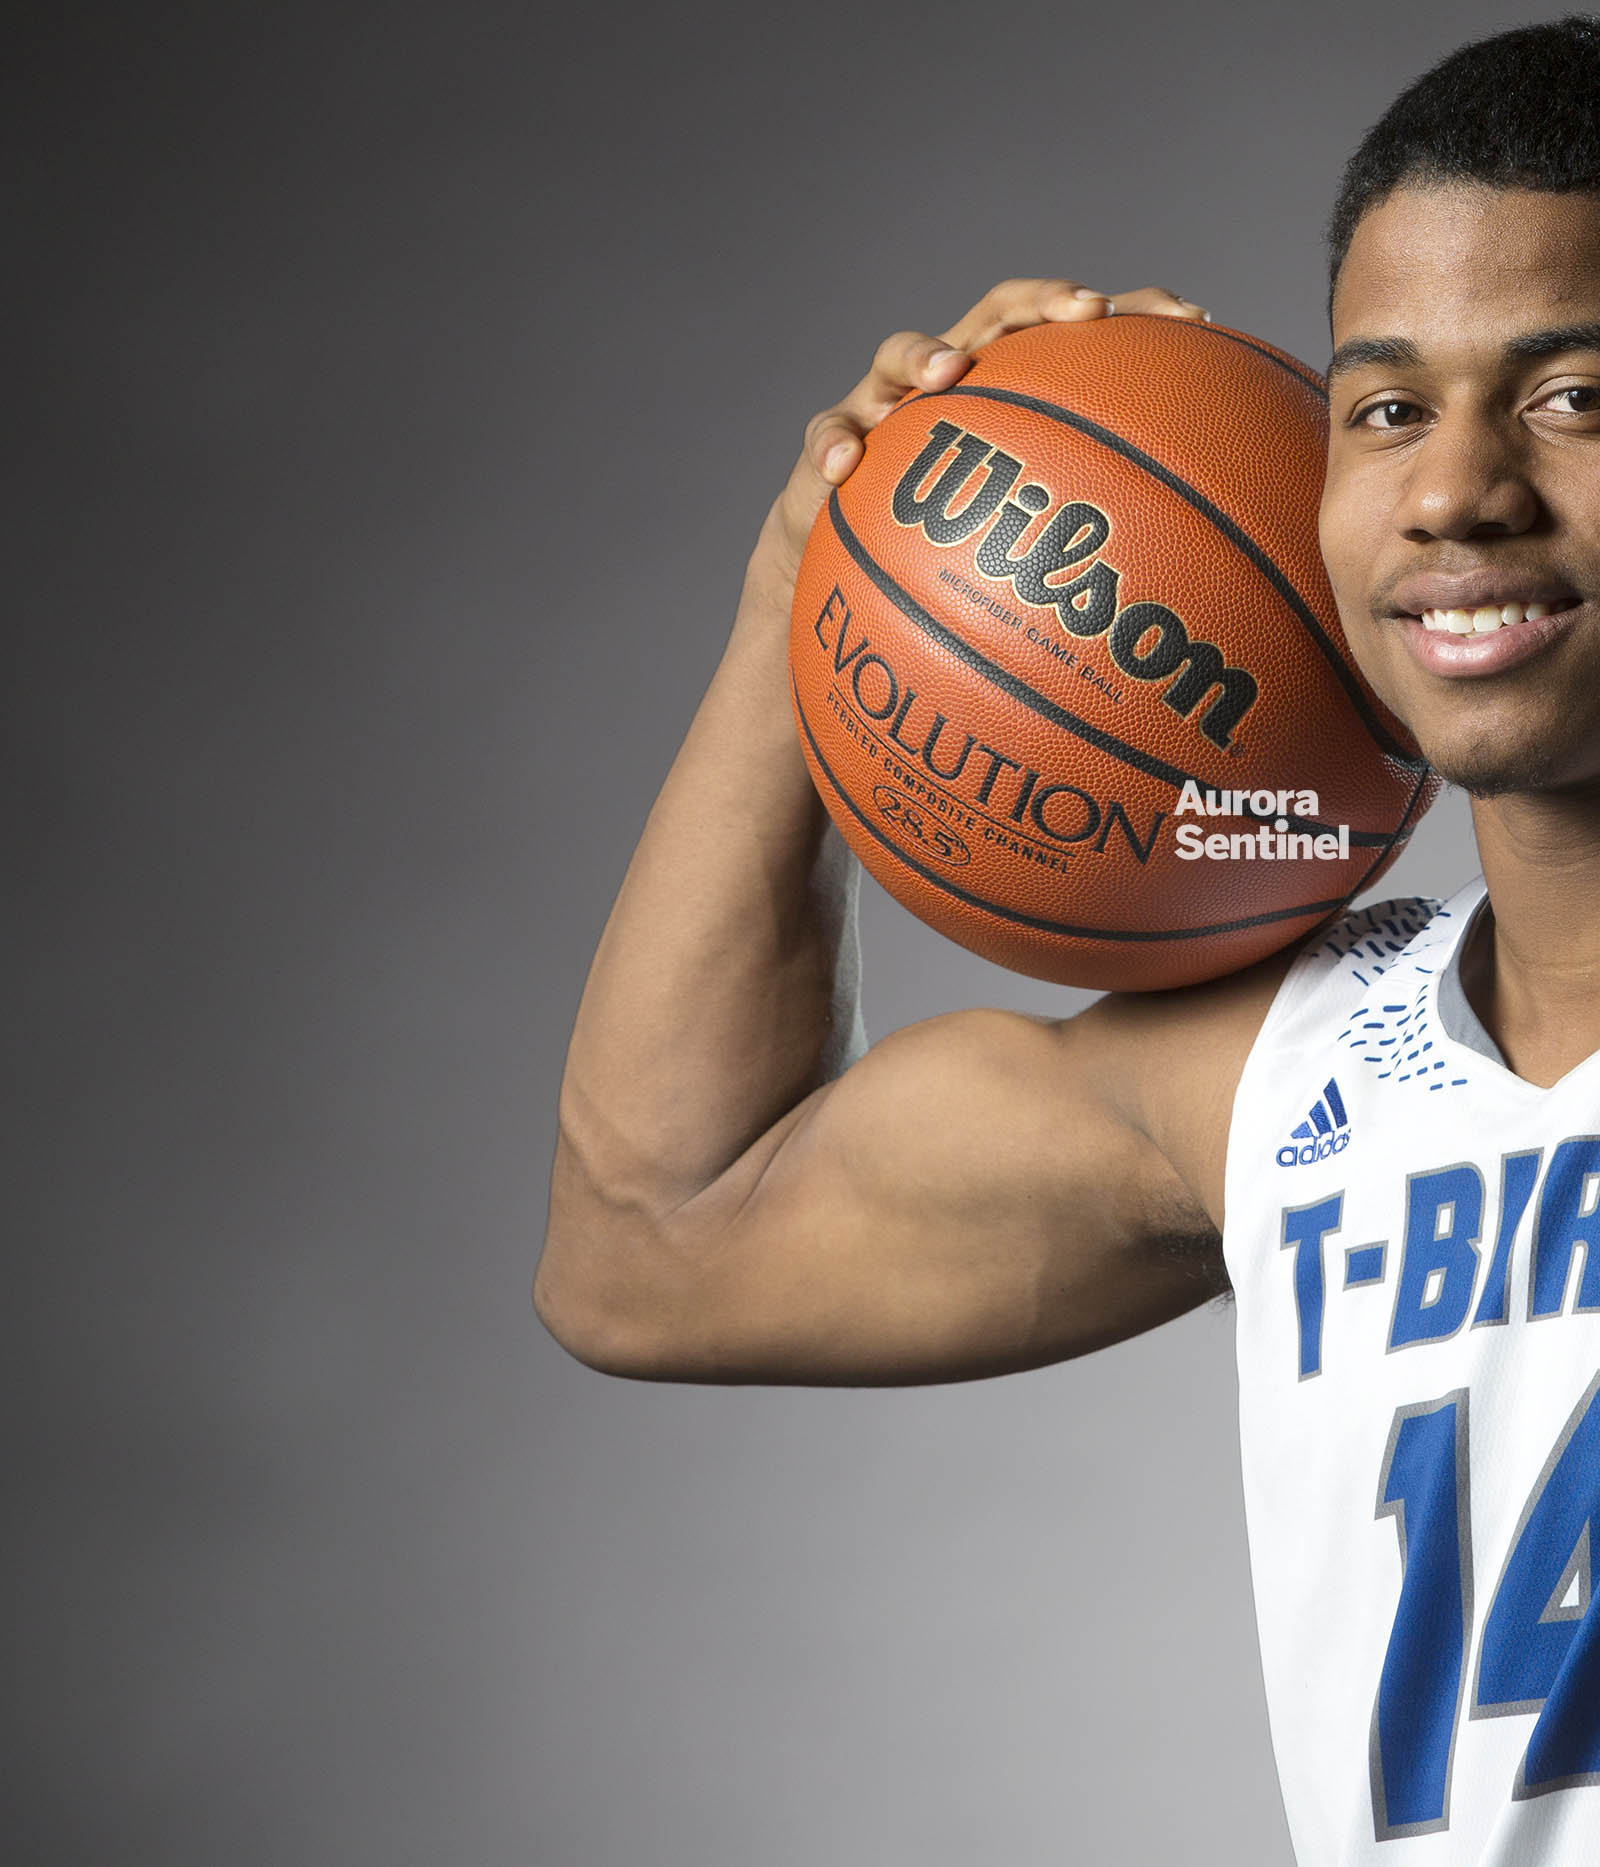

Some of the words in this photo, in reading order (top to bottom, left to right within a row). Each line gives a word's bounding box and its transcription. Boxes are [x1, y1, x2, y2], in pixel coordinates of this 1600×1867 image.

[892, 418, 1259, 753] Wilson
[938, 568, 1022, 630] MICROFIBER
[1026, 627, 1078, 669] GAME
[1080, 666, 1125, 705] BALL
[815, 584, 1168, 866] EVOLUTION
[827, 692, 877, 758] PEBBLED
[884, 757, 977, 831] COMPOSITE
[984, 827, 1070, 875] CHANNEL
[1275, 1127, 1351, 1167] adidas
